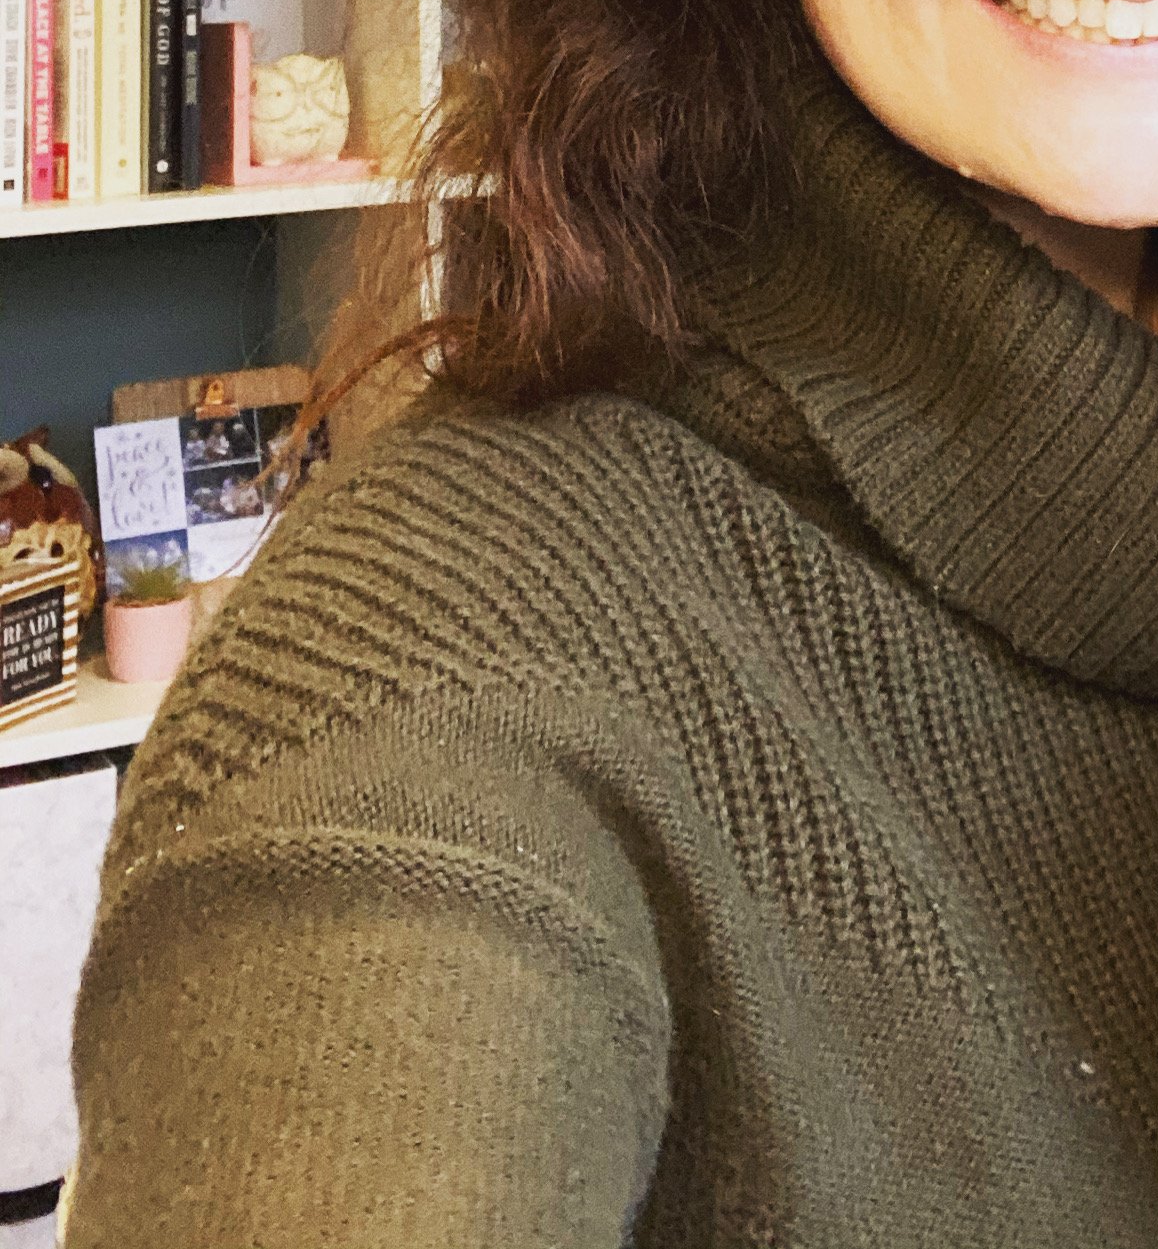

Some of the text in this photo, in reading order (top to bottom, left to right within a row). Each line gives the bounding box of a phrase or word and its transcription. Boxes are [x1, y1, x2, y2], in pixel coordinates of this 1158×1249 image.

[36, 43, 49, 64] AT
[157, 24, 170, 65] GOD
[36, 68, 49, 99] THE
[36, 104, 49, 154] TABLE
